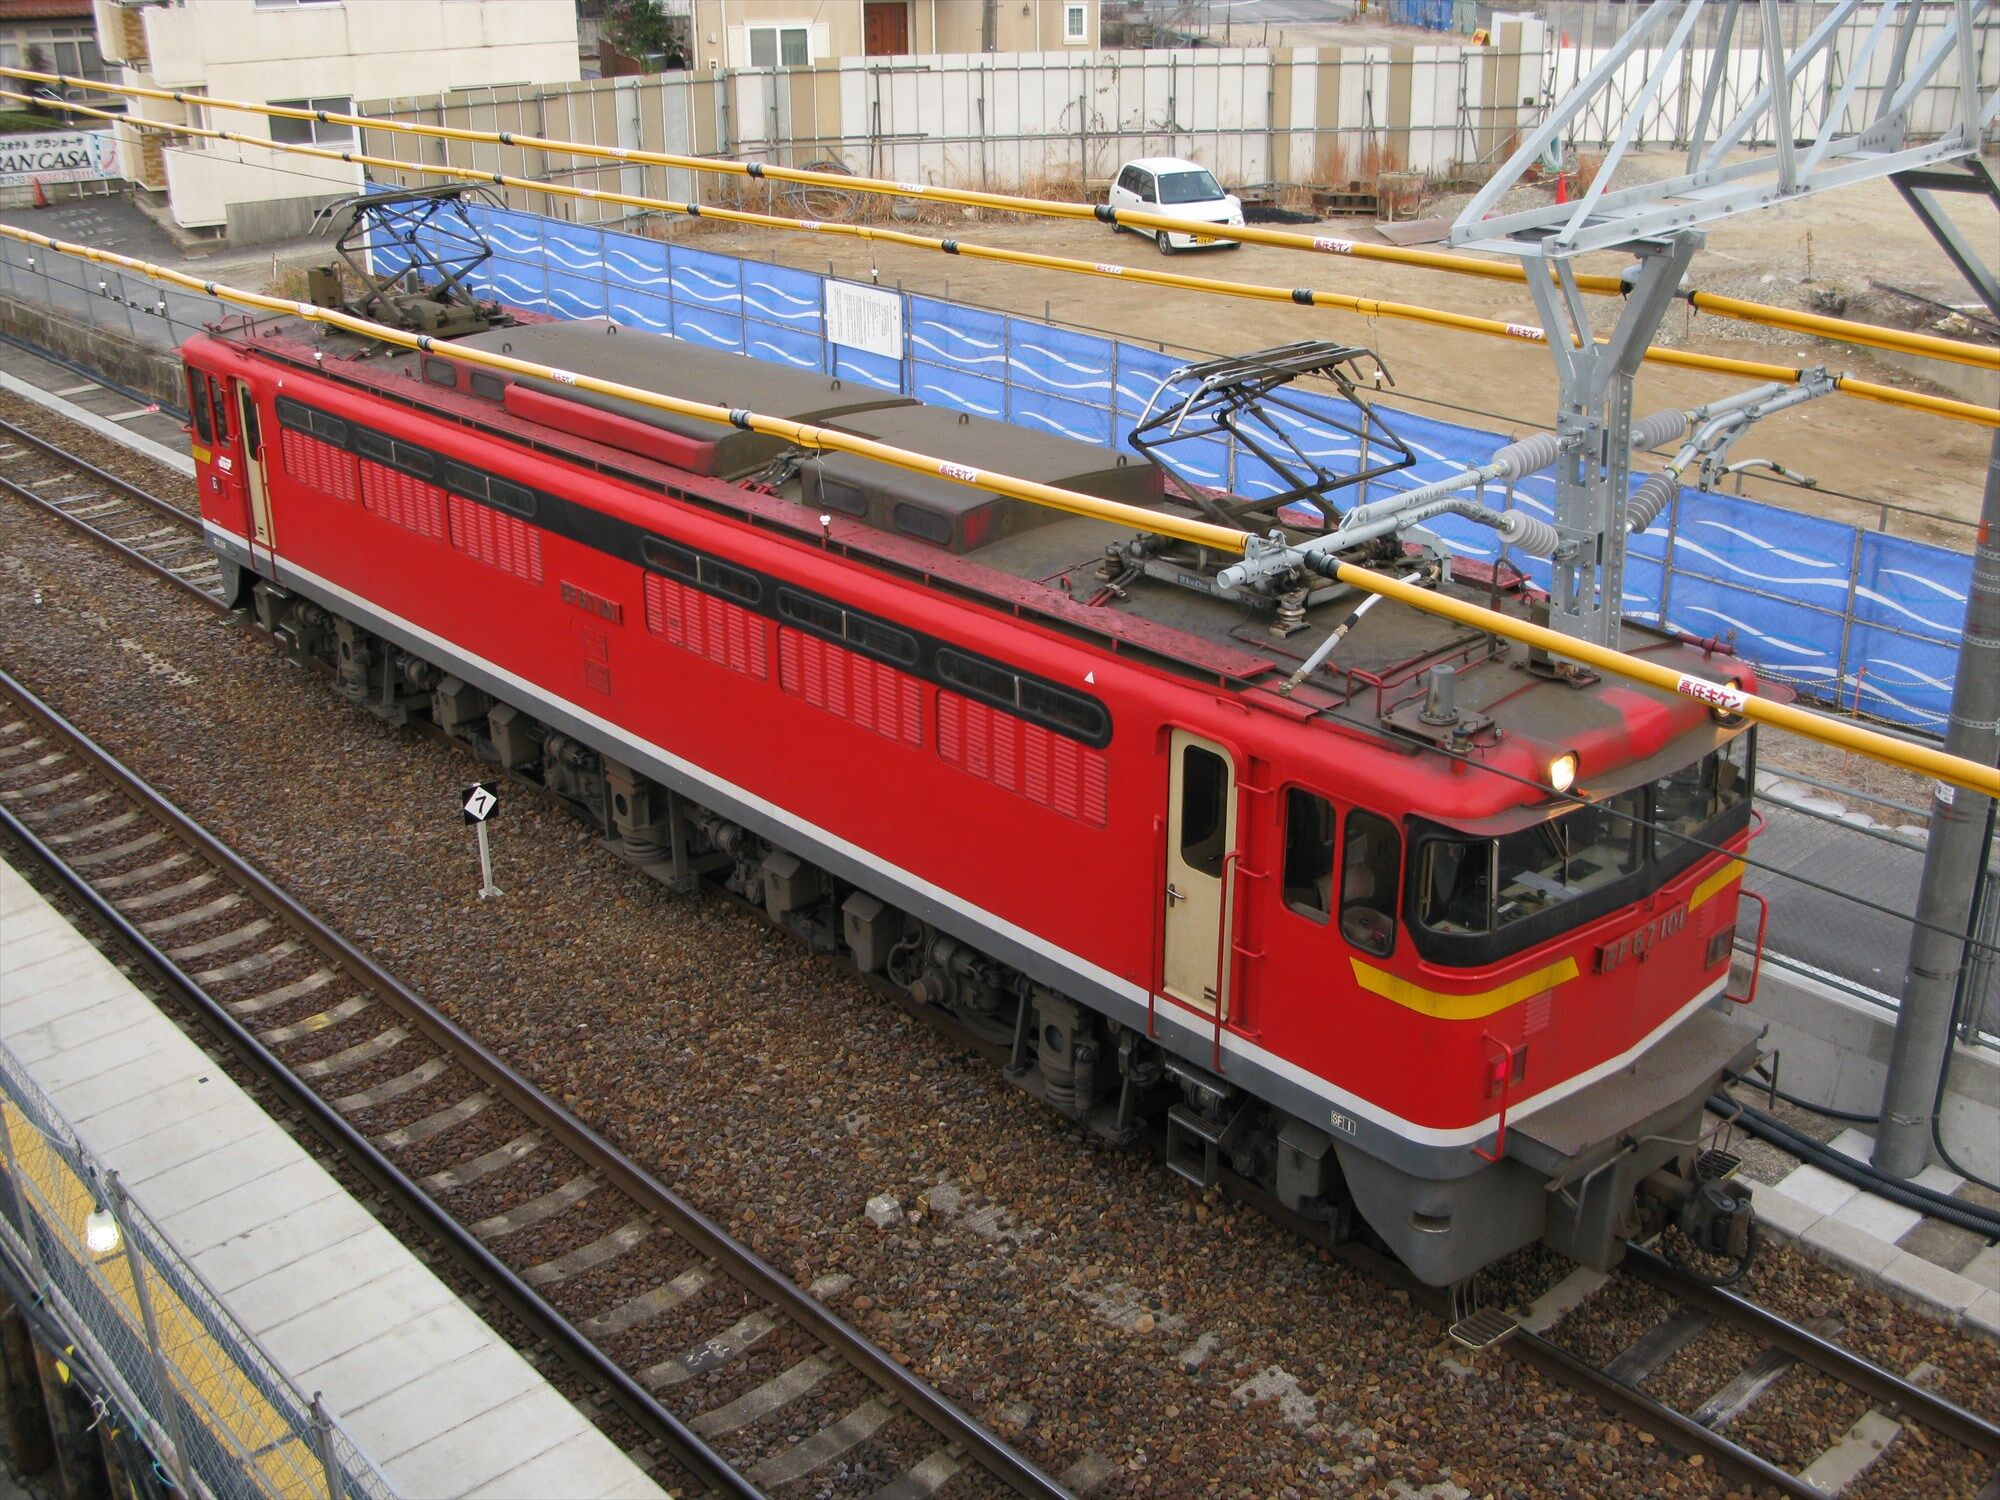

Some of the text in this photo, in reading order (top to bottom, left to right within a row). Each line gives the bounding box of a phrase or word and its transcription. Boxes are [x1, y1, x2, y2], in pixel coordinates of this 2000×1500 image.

[39, 150, 91, 169] CASA
[1680, 680, 1741, 709] 高圧キケン
[475, 795, 486, 813] 7
